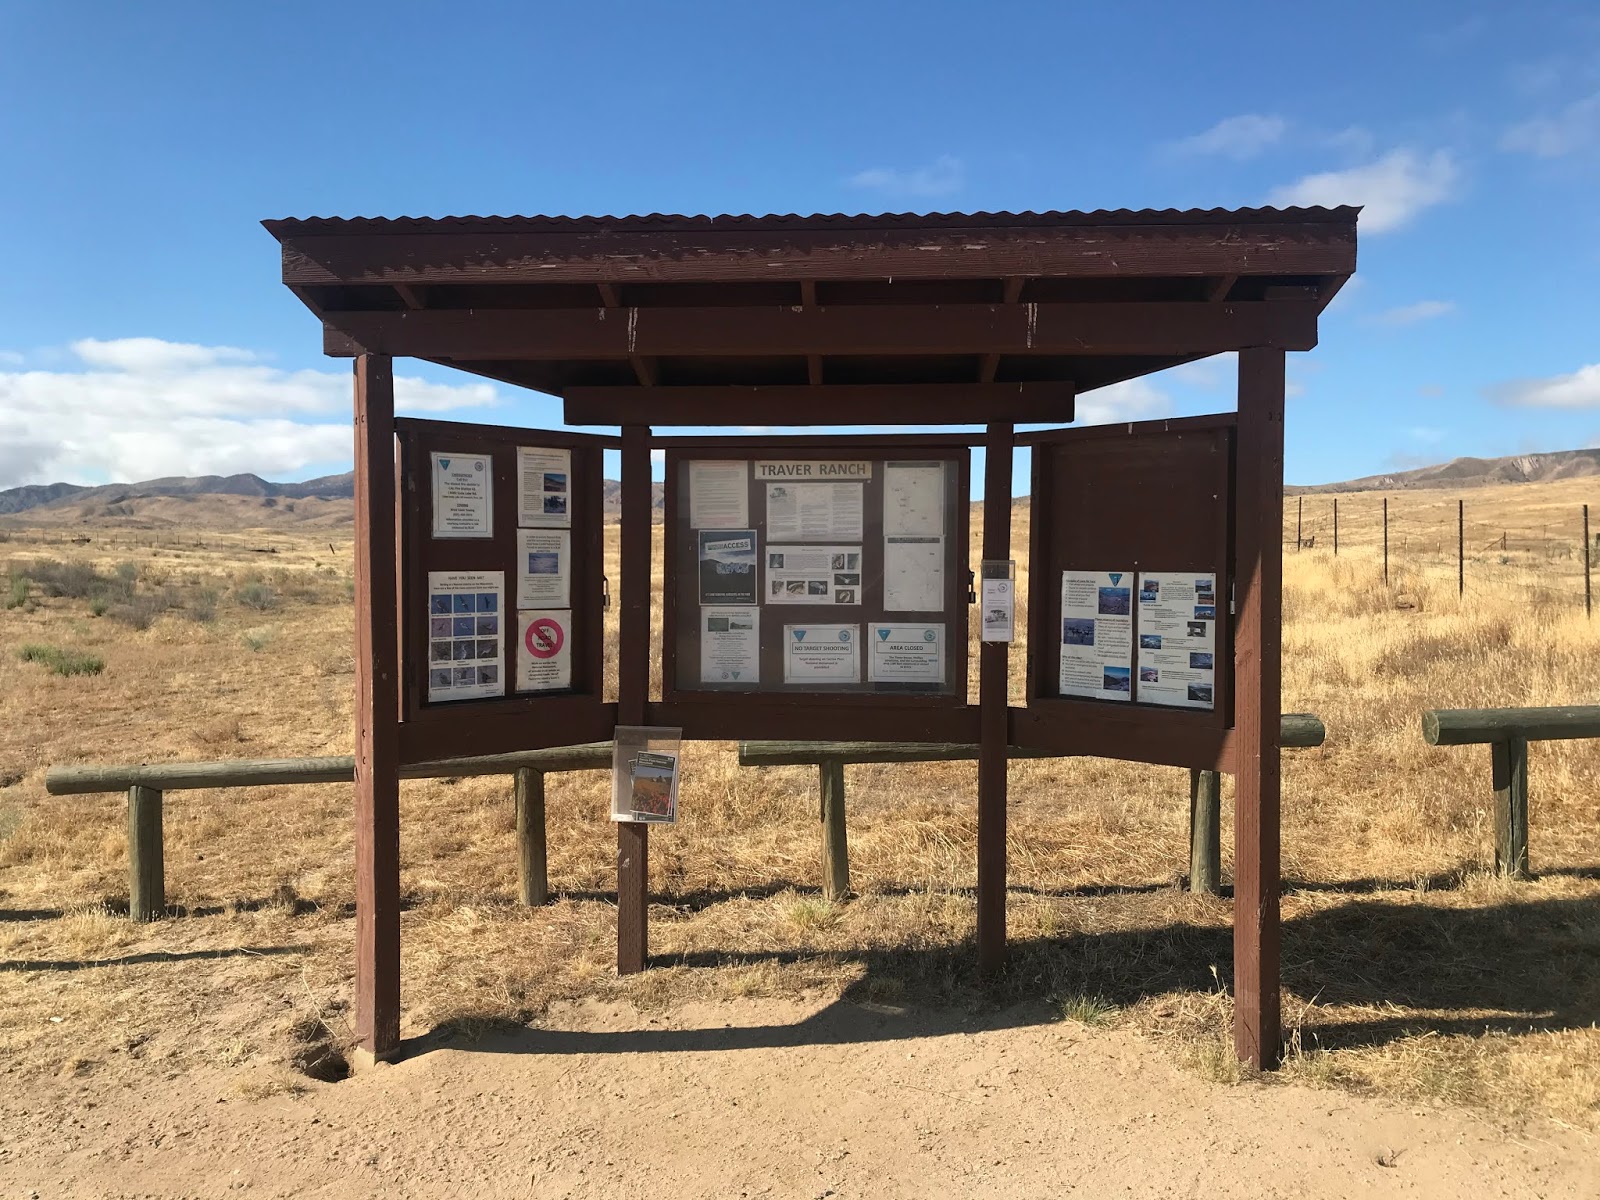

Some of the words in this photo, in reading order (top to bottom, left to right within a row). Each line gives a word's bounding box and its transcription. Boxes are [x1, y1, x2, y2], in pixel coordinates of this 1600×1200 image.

[760, 464, 811, 476] TRAVER
[819, 463, 866, 475] RANCH
[723, 541, 749, 549] ACCESS
